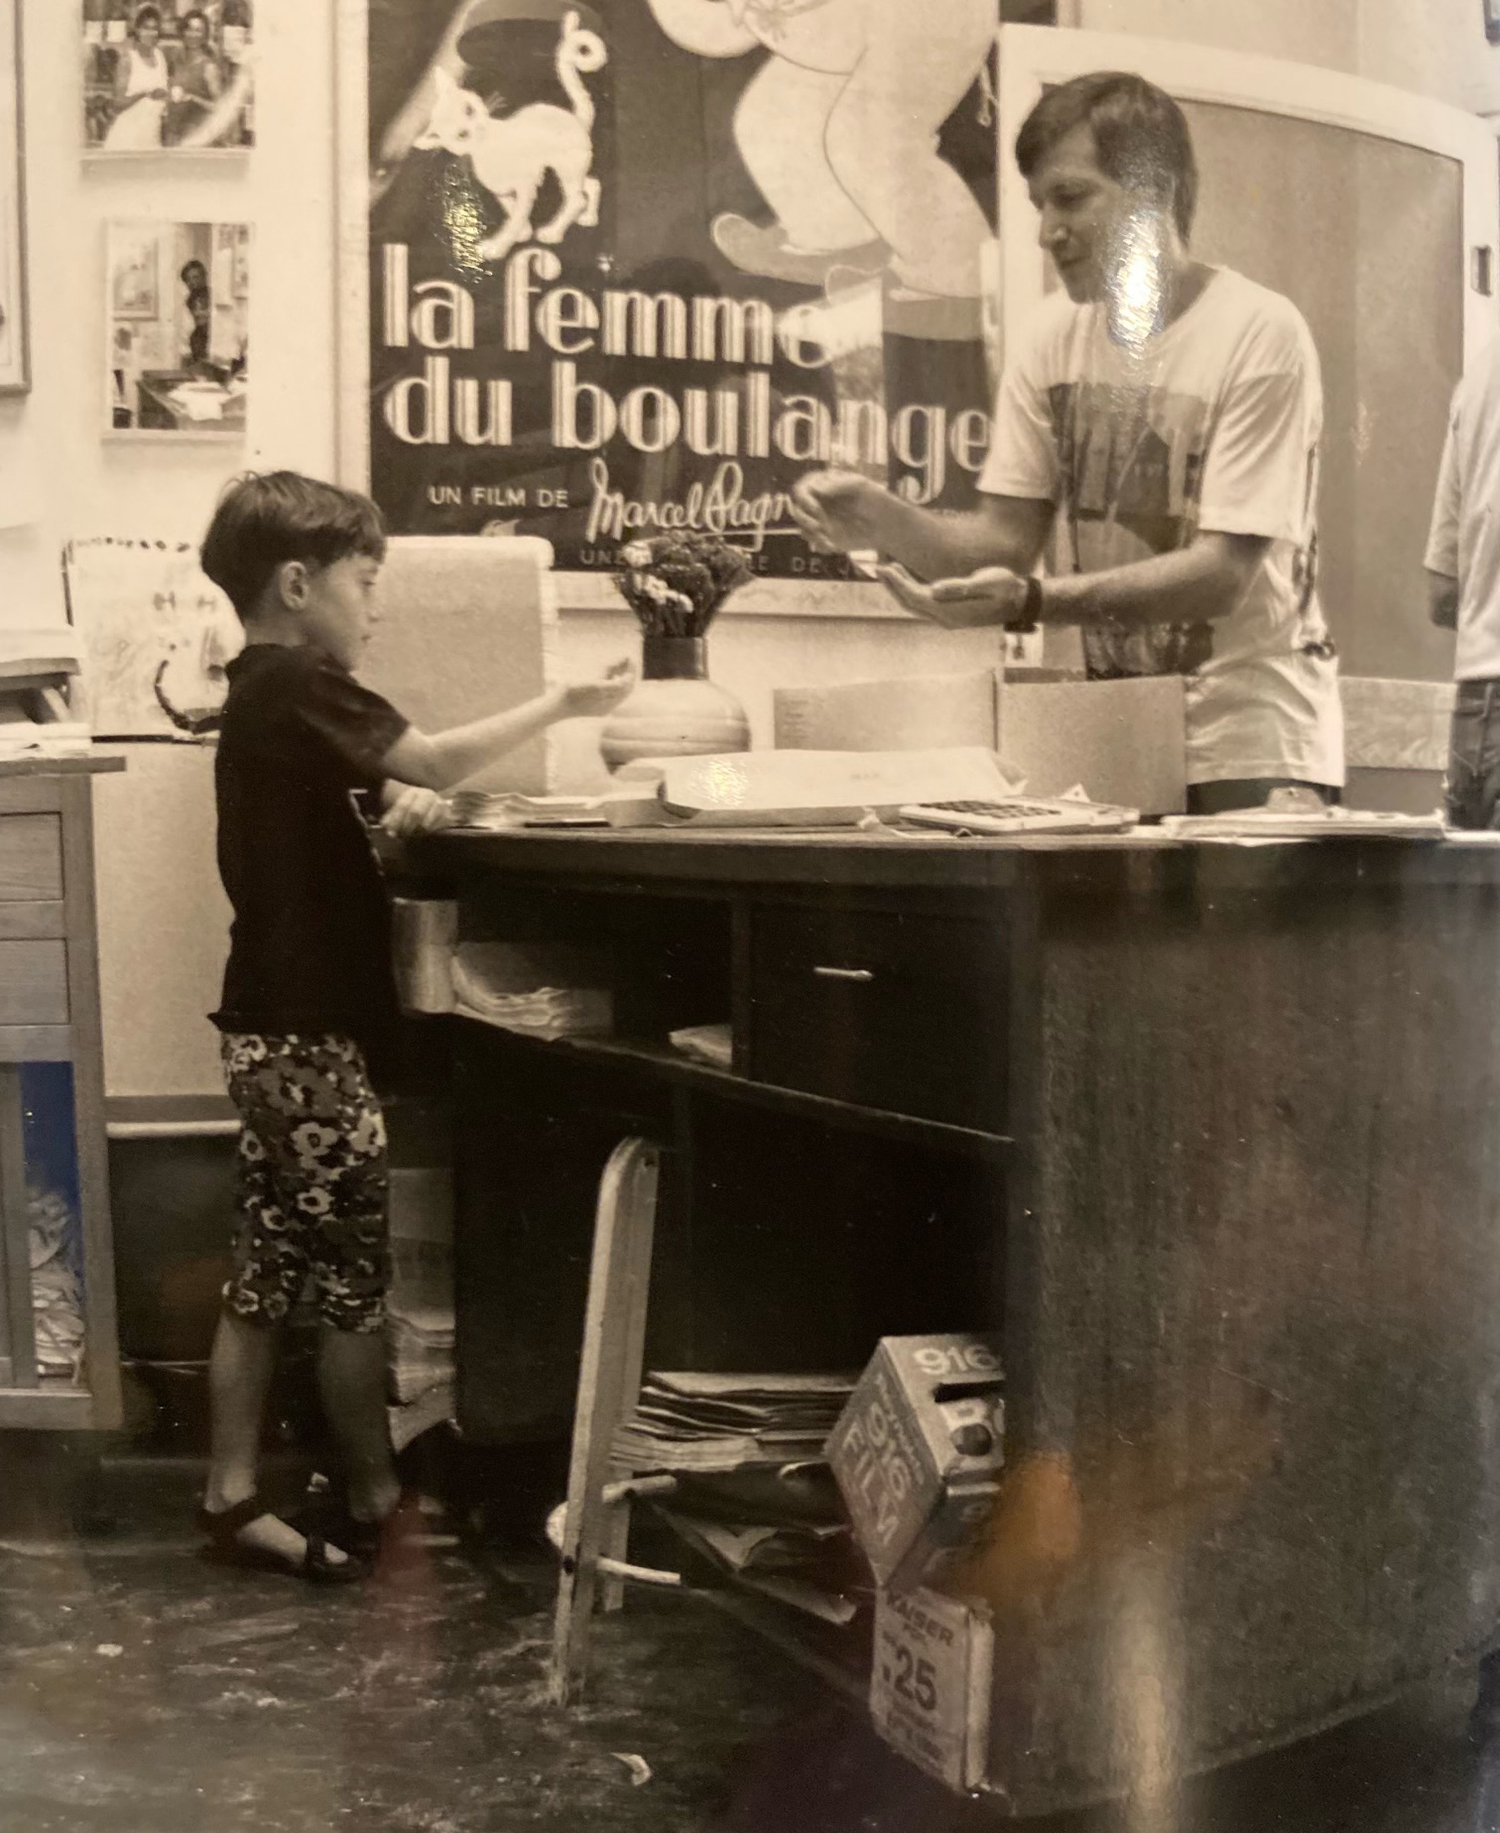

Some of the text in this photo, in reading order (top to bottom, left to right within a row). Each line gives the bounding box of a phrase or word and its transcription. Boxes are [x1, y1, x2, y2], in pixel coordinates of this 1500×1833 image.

[383, 244, 834, 368] la femme
[384, 356, 992, 504] du boulange
[428, 485, 569, 509] UN FILM DE
[586, 457, 797, 553] Marcel Pagn
